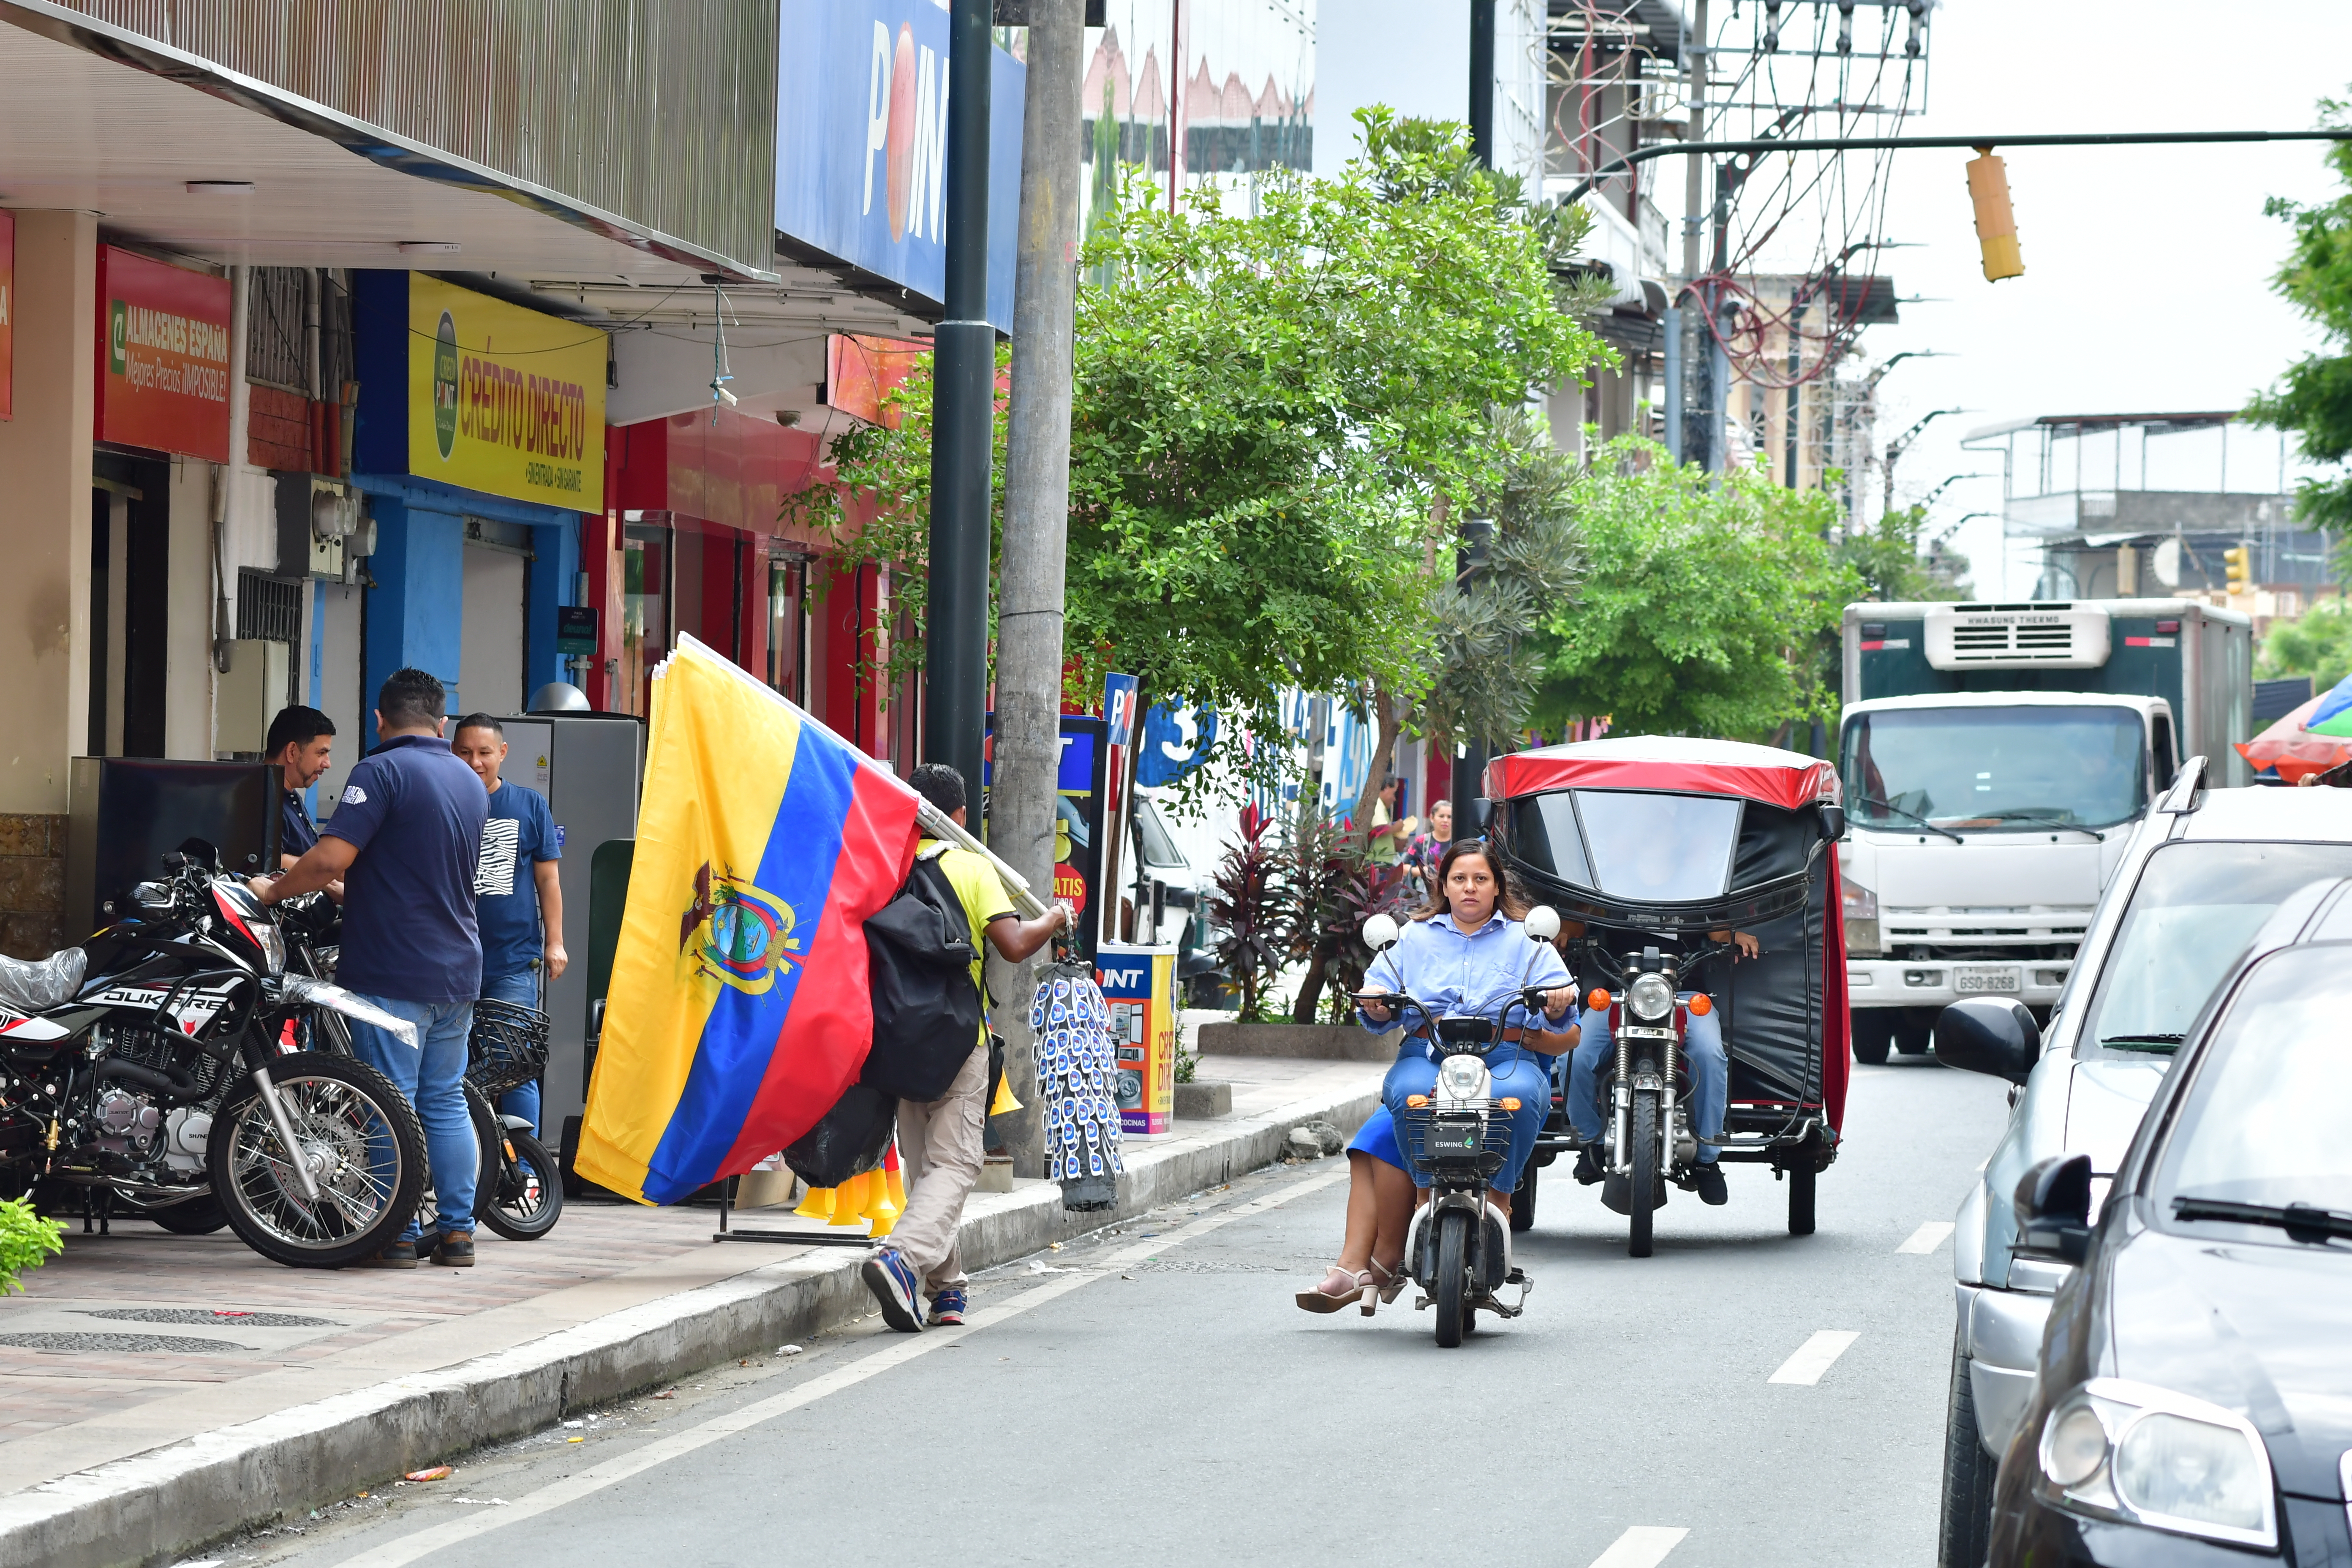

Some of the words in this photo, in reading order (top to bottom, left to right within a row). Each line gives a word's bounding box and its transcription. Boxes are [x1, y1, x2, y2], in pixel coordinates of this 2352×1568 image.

[863, 20, 950, 246] POIN
[126, 305, 187, 354] ALMACENES
[190, 319, 227, 363] ESPAÑA
[126, 351, 154, 393] Mejores
[156, 357, 180, 393] Precios
[440, 355, 455, 381] CREDI
[436, 380, 455, 410] POINT
[461, 336, 523, 450] CRÉDITO
[527, 374, 585, 462] DIRECTO
[1054, 877, 1083, 896] ATIS
[1120, 1119, 1146, 1127] COCINAS
